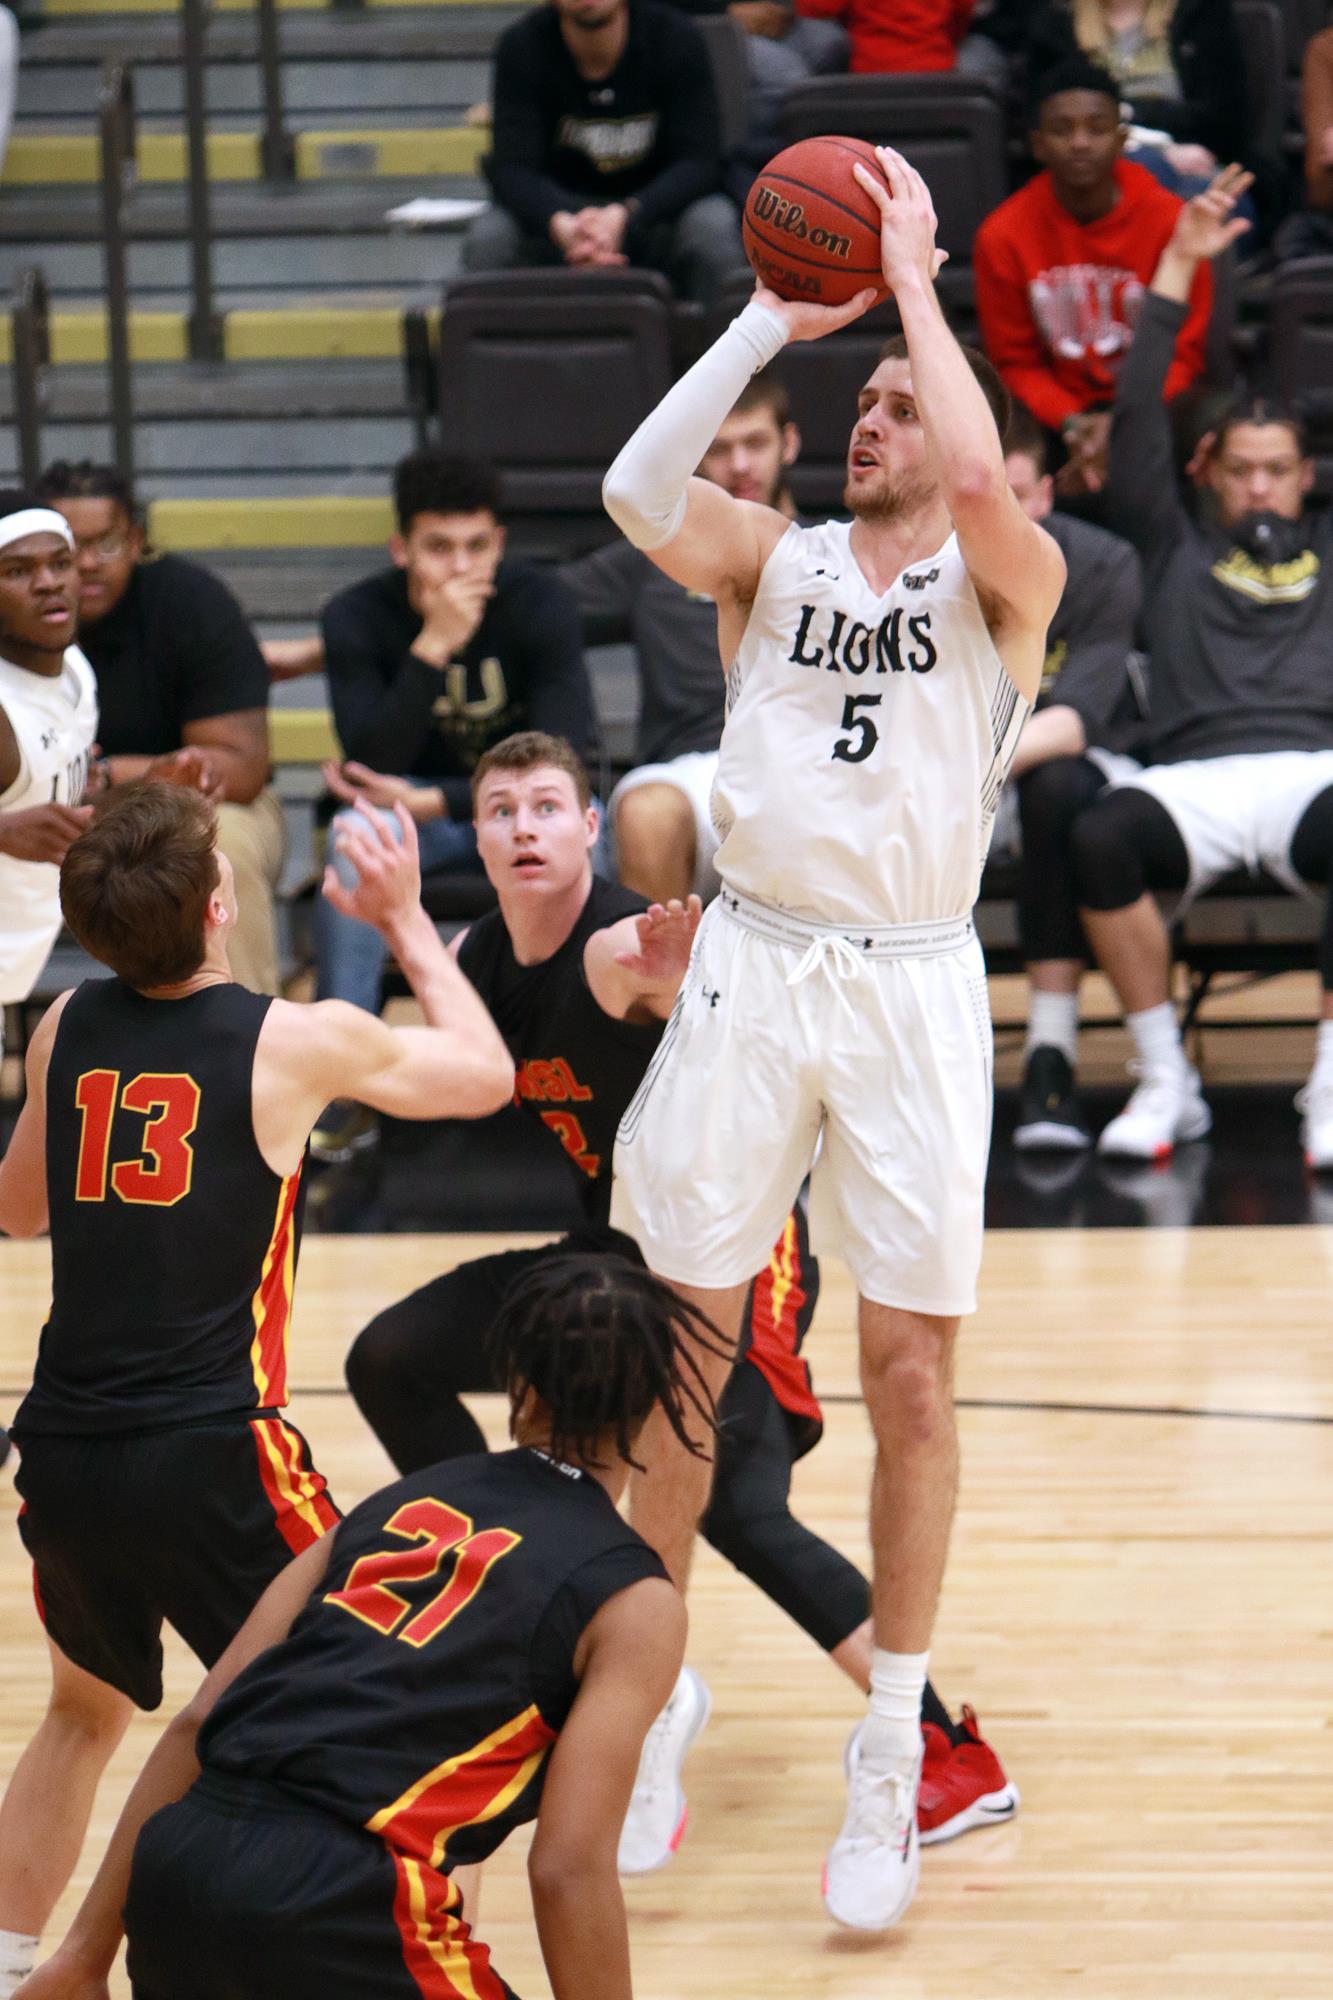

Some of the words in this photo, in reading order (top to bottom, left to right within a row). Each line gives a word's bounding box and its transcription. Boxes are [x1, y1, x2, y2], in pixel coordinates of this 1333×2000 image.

[752, 185, 853, 260] Wilson
[788, 604, 938, 675] LIONS
[831, 693, 883, 764] 5
[75, 1068, 202, 1207] 13
[322, 1496, 524, 1649] 21
